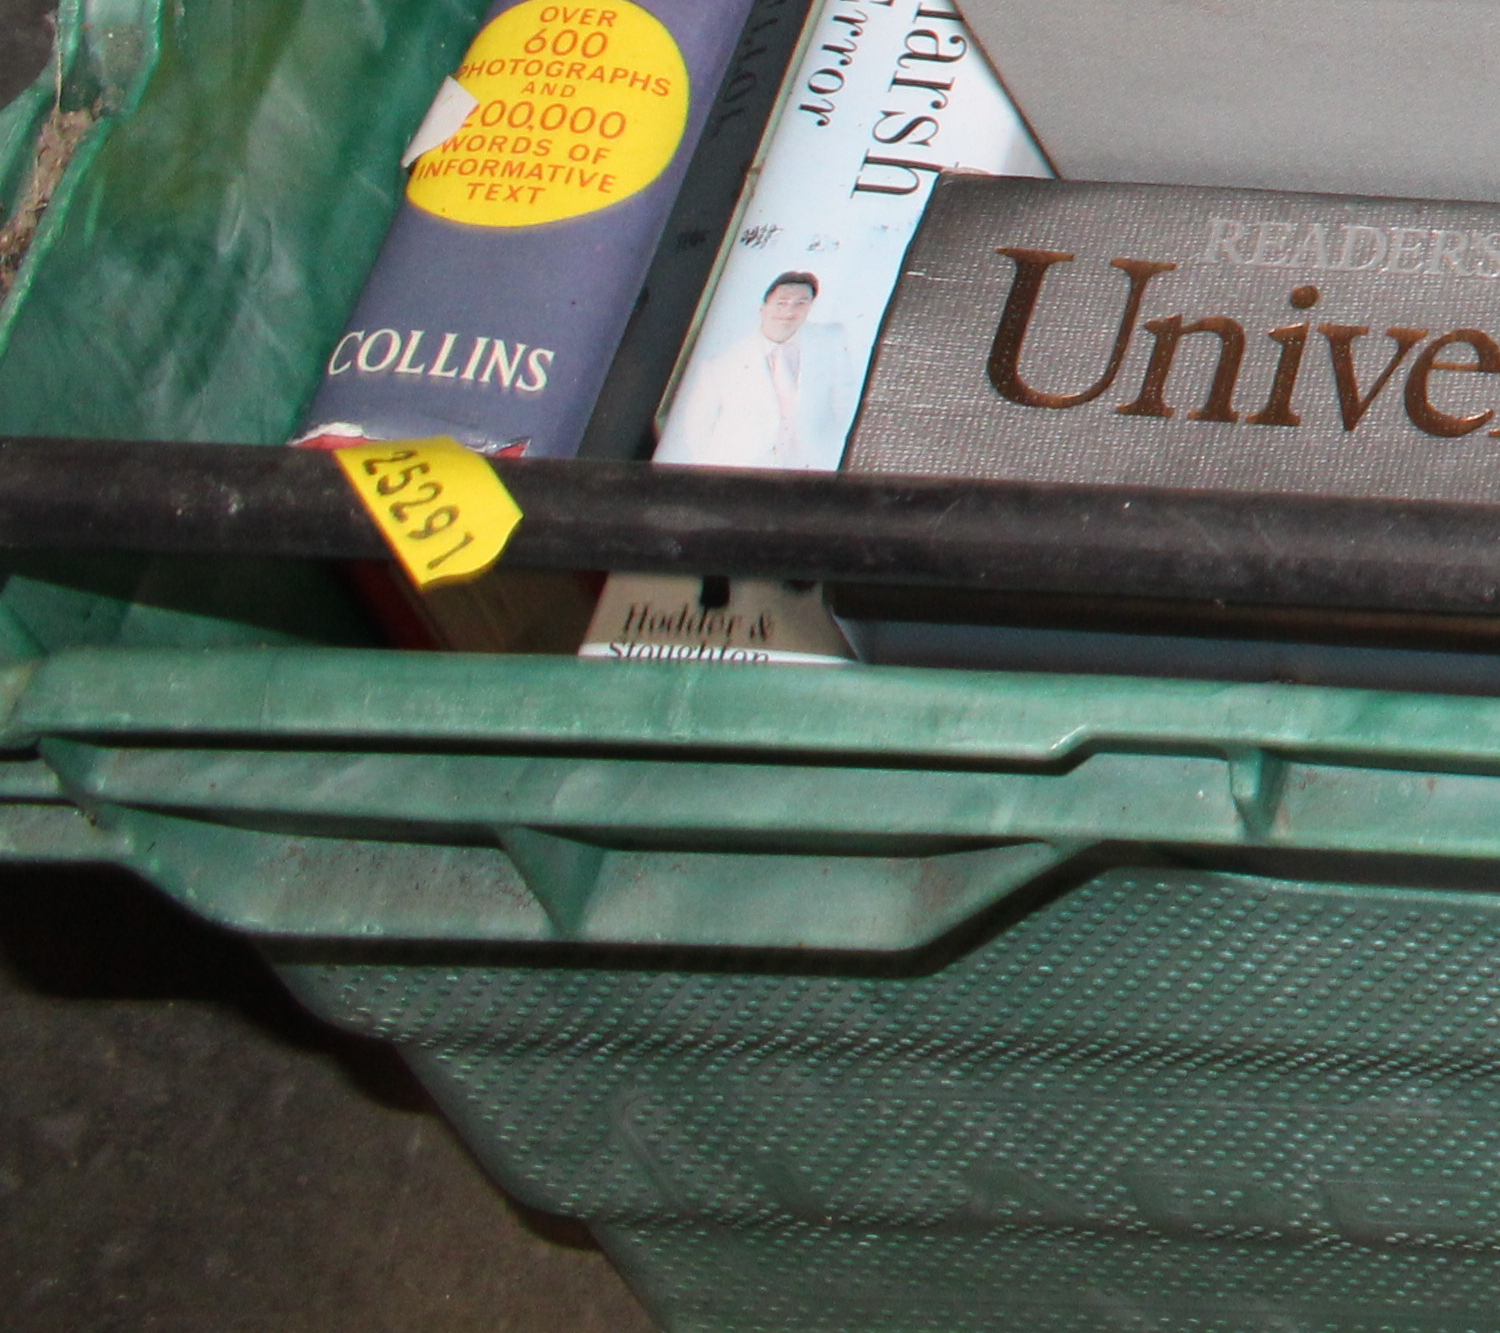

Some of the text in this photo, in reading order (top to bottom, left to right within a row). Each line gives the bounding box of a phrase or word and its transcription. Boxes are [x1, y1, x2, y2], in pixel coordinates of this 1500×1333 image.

[540, 6, 617, 28] OVER
[524, 28, 609, 59] 600
[456, 58, 672, 97] PHOTOGRAPHS
[521, 81, 577, 99] AND
[441, 134, 611, 165] WORDS OF
[416, 157, 617, 194] INFORMATIVE
[466, 181, 546, 205] TEXT
[328, 328, 554, 393] COLLINS
[362, 449, 475, 570] 25291
